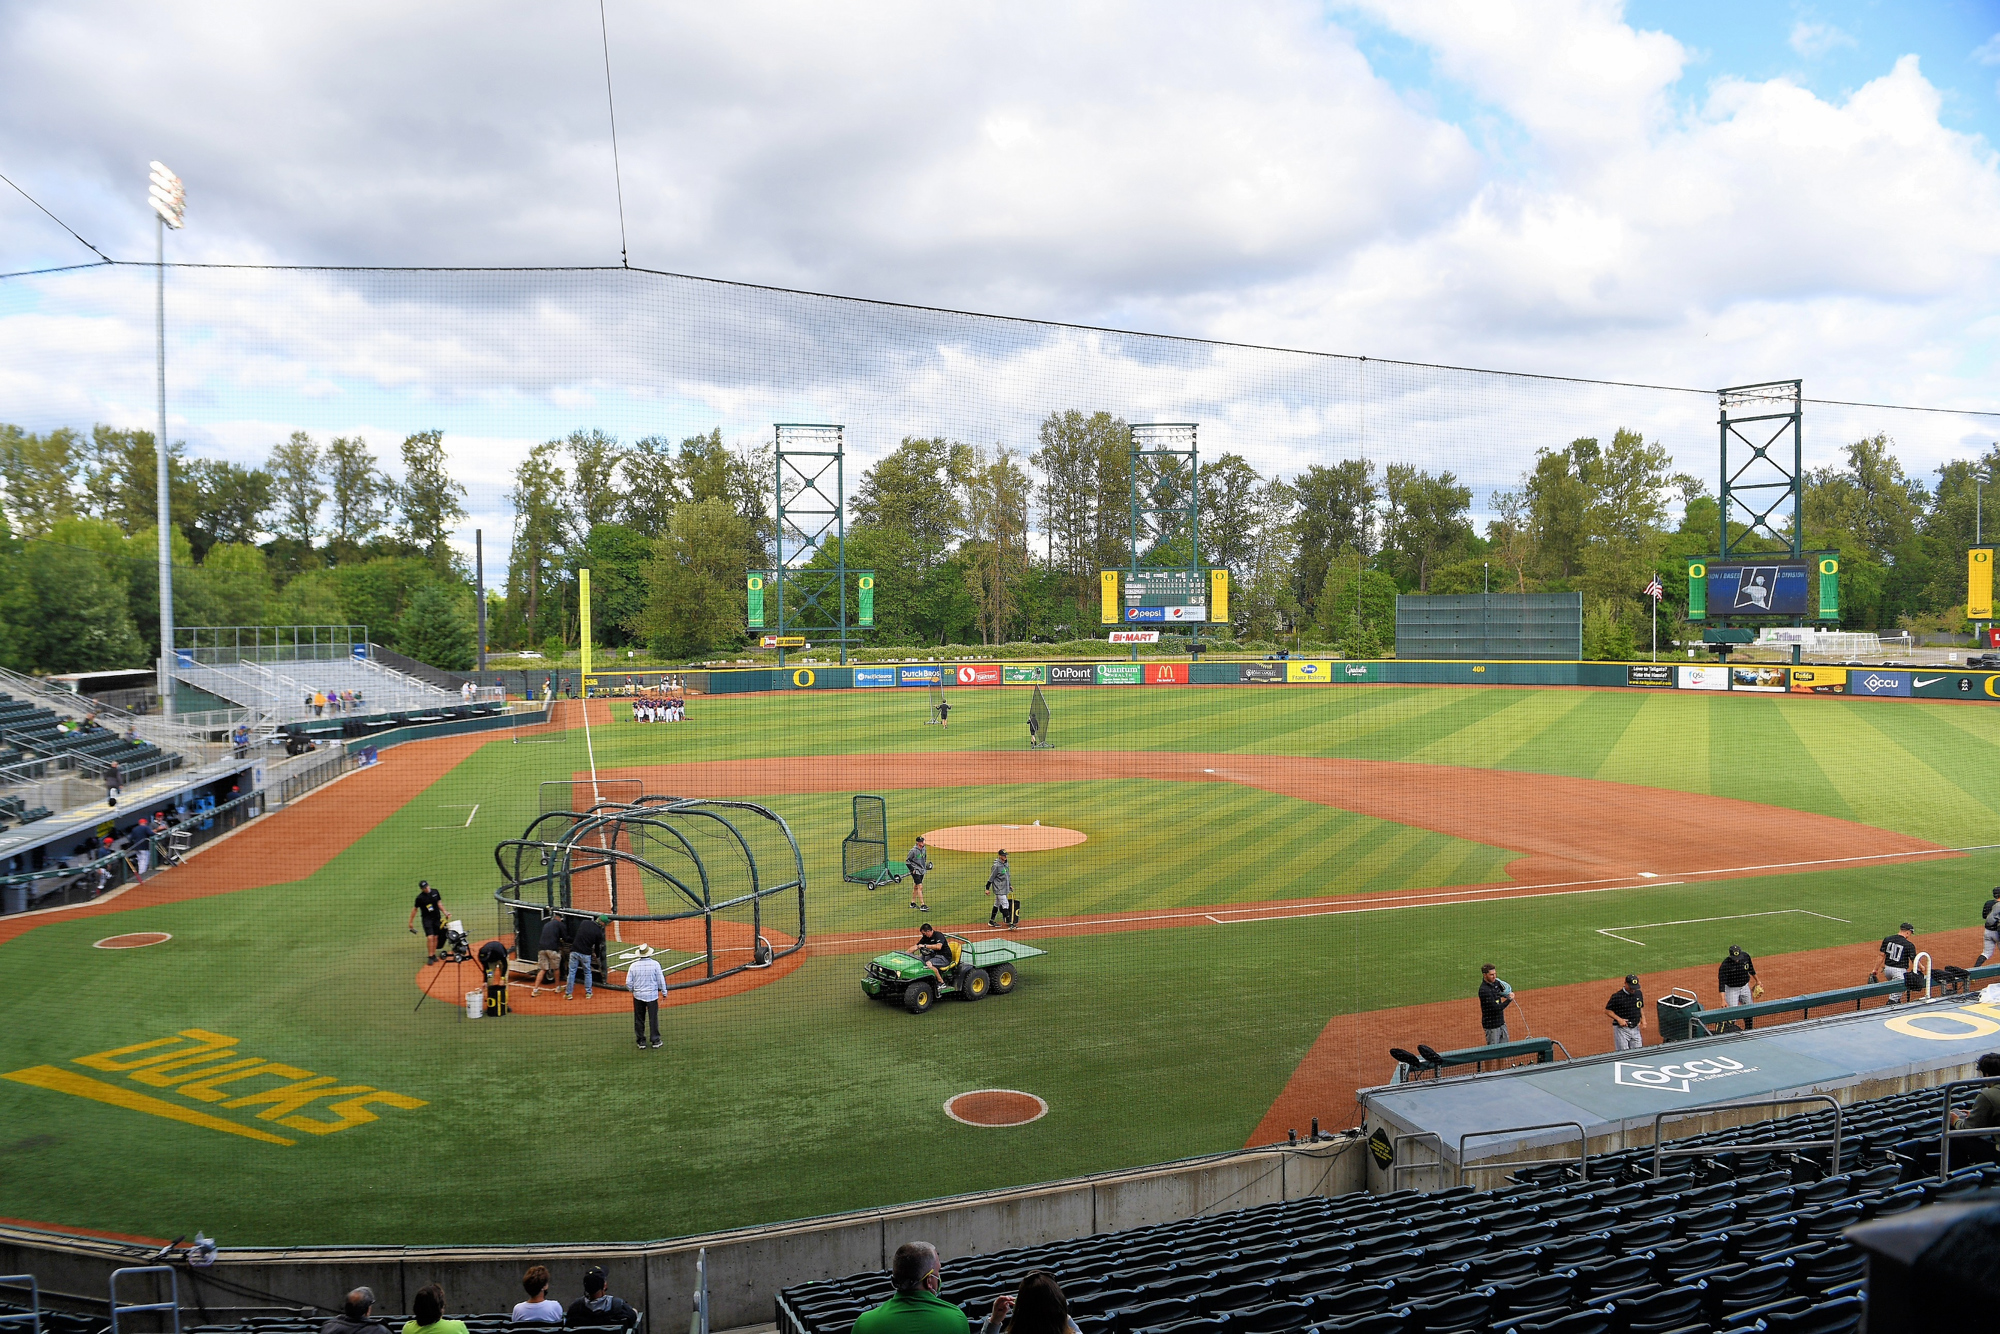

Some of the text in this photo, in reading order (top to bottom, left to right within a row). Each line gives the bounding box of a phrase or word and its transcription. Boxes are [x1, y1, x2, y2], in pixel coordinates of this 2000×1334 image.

[1689, 564, 1705, 578] O
[1820, 559, 1838, 575] O
[748, 578, 763, 590] O
[859, 577, 873, 589] O
[1139, 609, 1162, 618] pepsi
[1052, 667, 1091, 678] OnPoint
[1097, 664, 1137, 677] Quantum
[793, 669, 815, 687] O
[1869, 680, 1898, 688] OCCU
[1886, 942, 1904, 962] 40
[1631, 1056, 1744, 1084] OCCU
[70, 1027, 429, 1135] DUCKS
